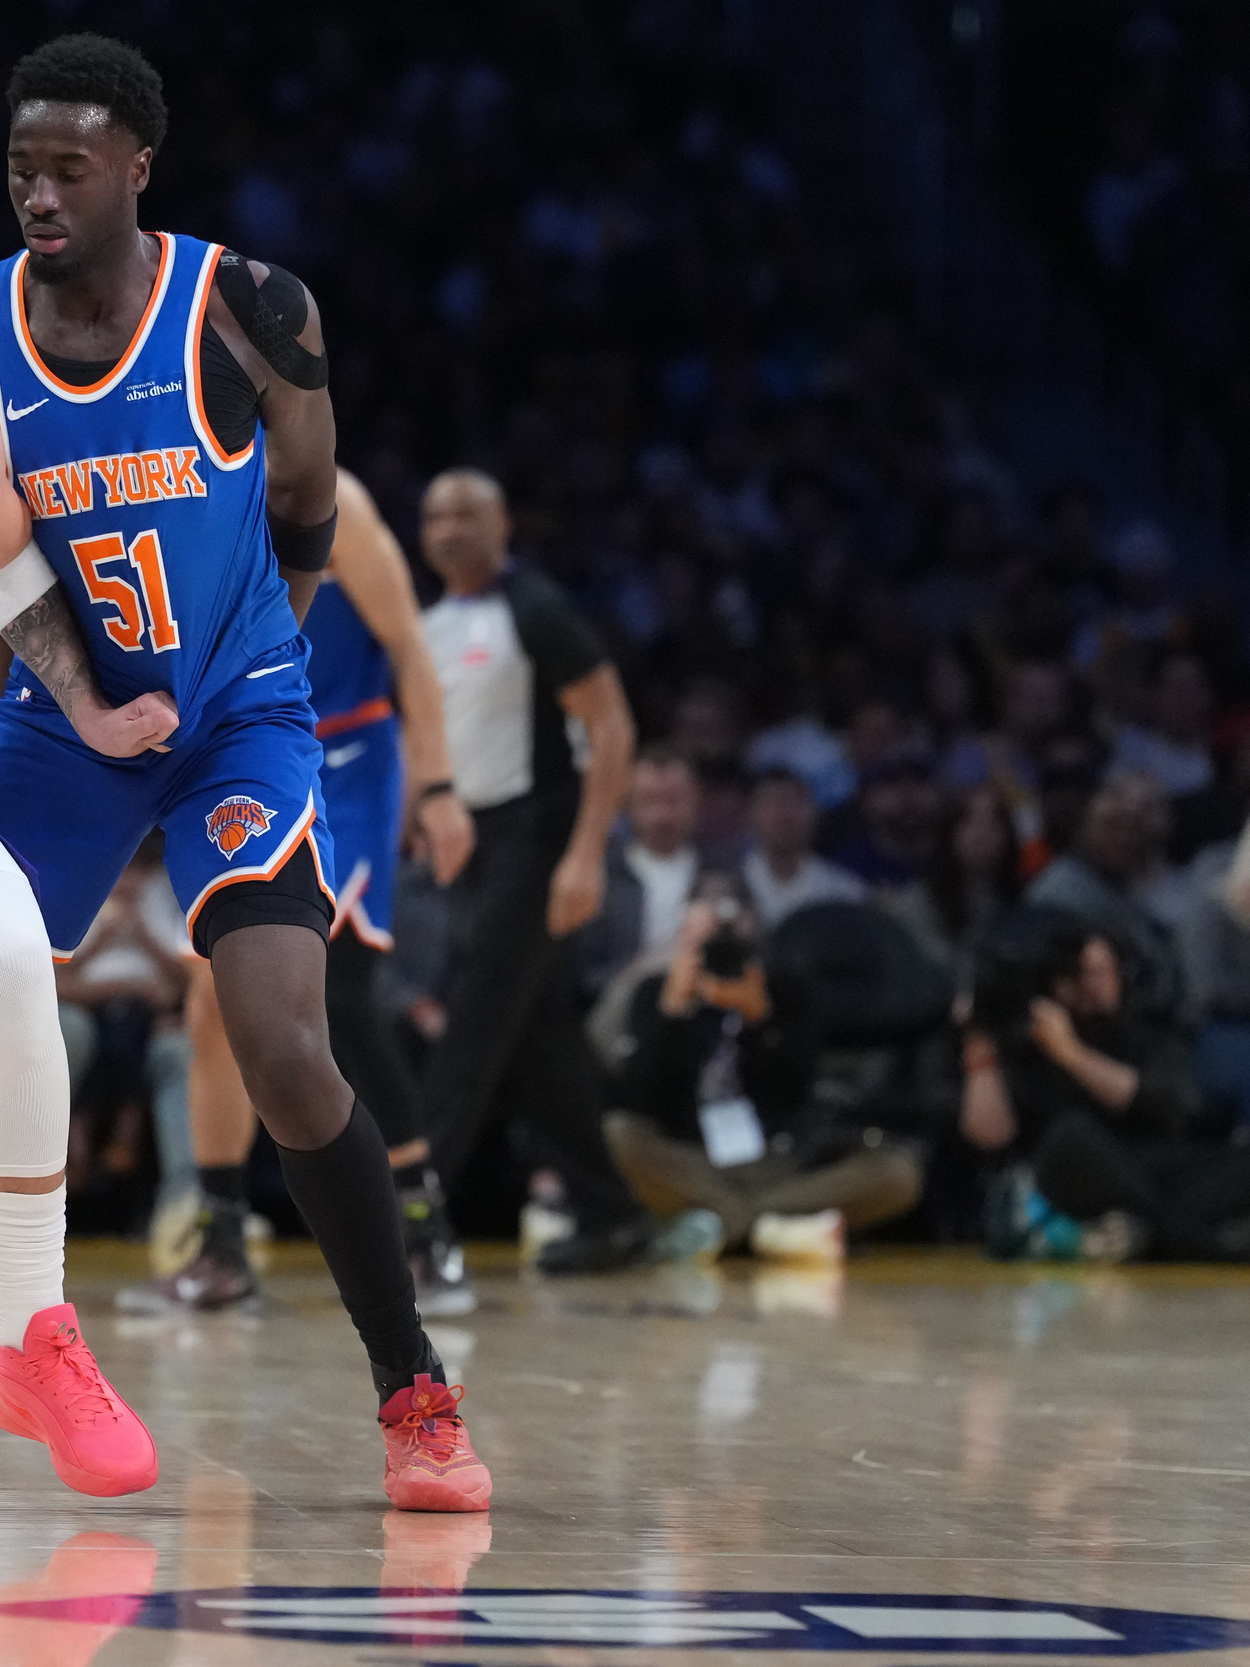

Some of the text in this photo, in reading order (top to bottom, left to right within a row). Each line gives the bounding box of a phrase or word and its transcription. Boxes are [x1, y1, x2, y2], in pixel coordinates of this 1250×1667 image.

[126, 380, 183, 402] abu dhabi
[17, 446, 208, 520] NEW YORK
[69, 528, 181, 655] 51
[208, 802, 268, 835] KNICKS
